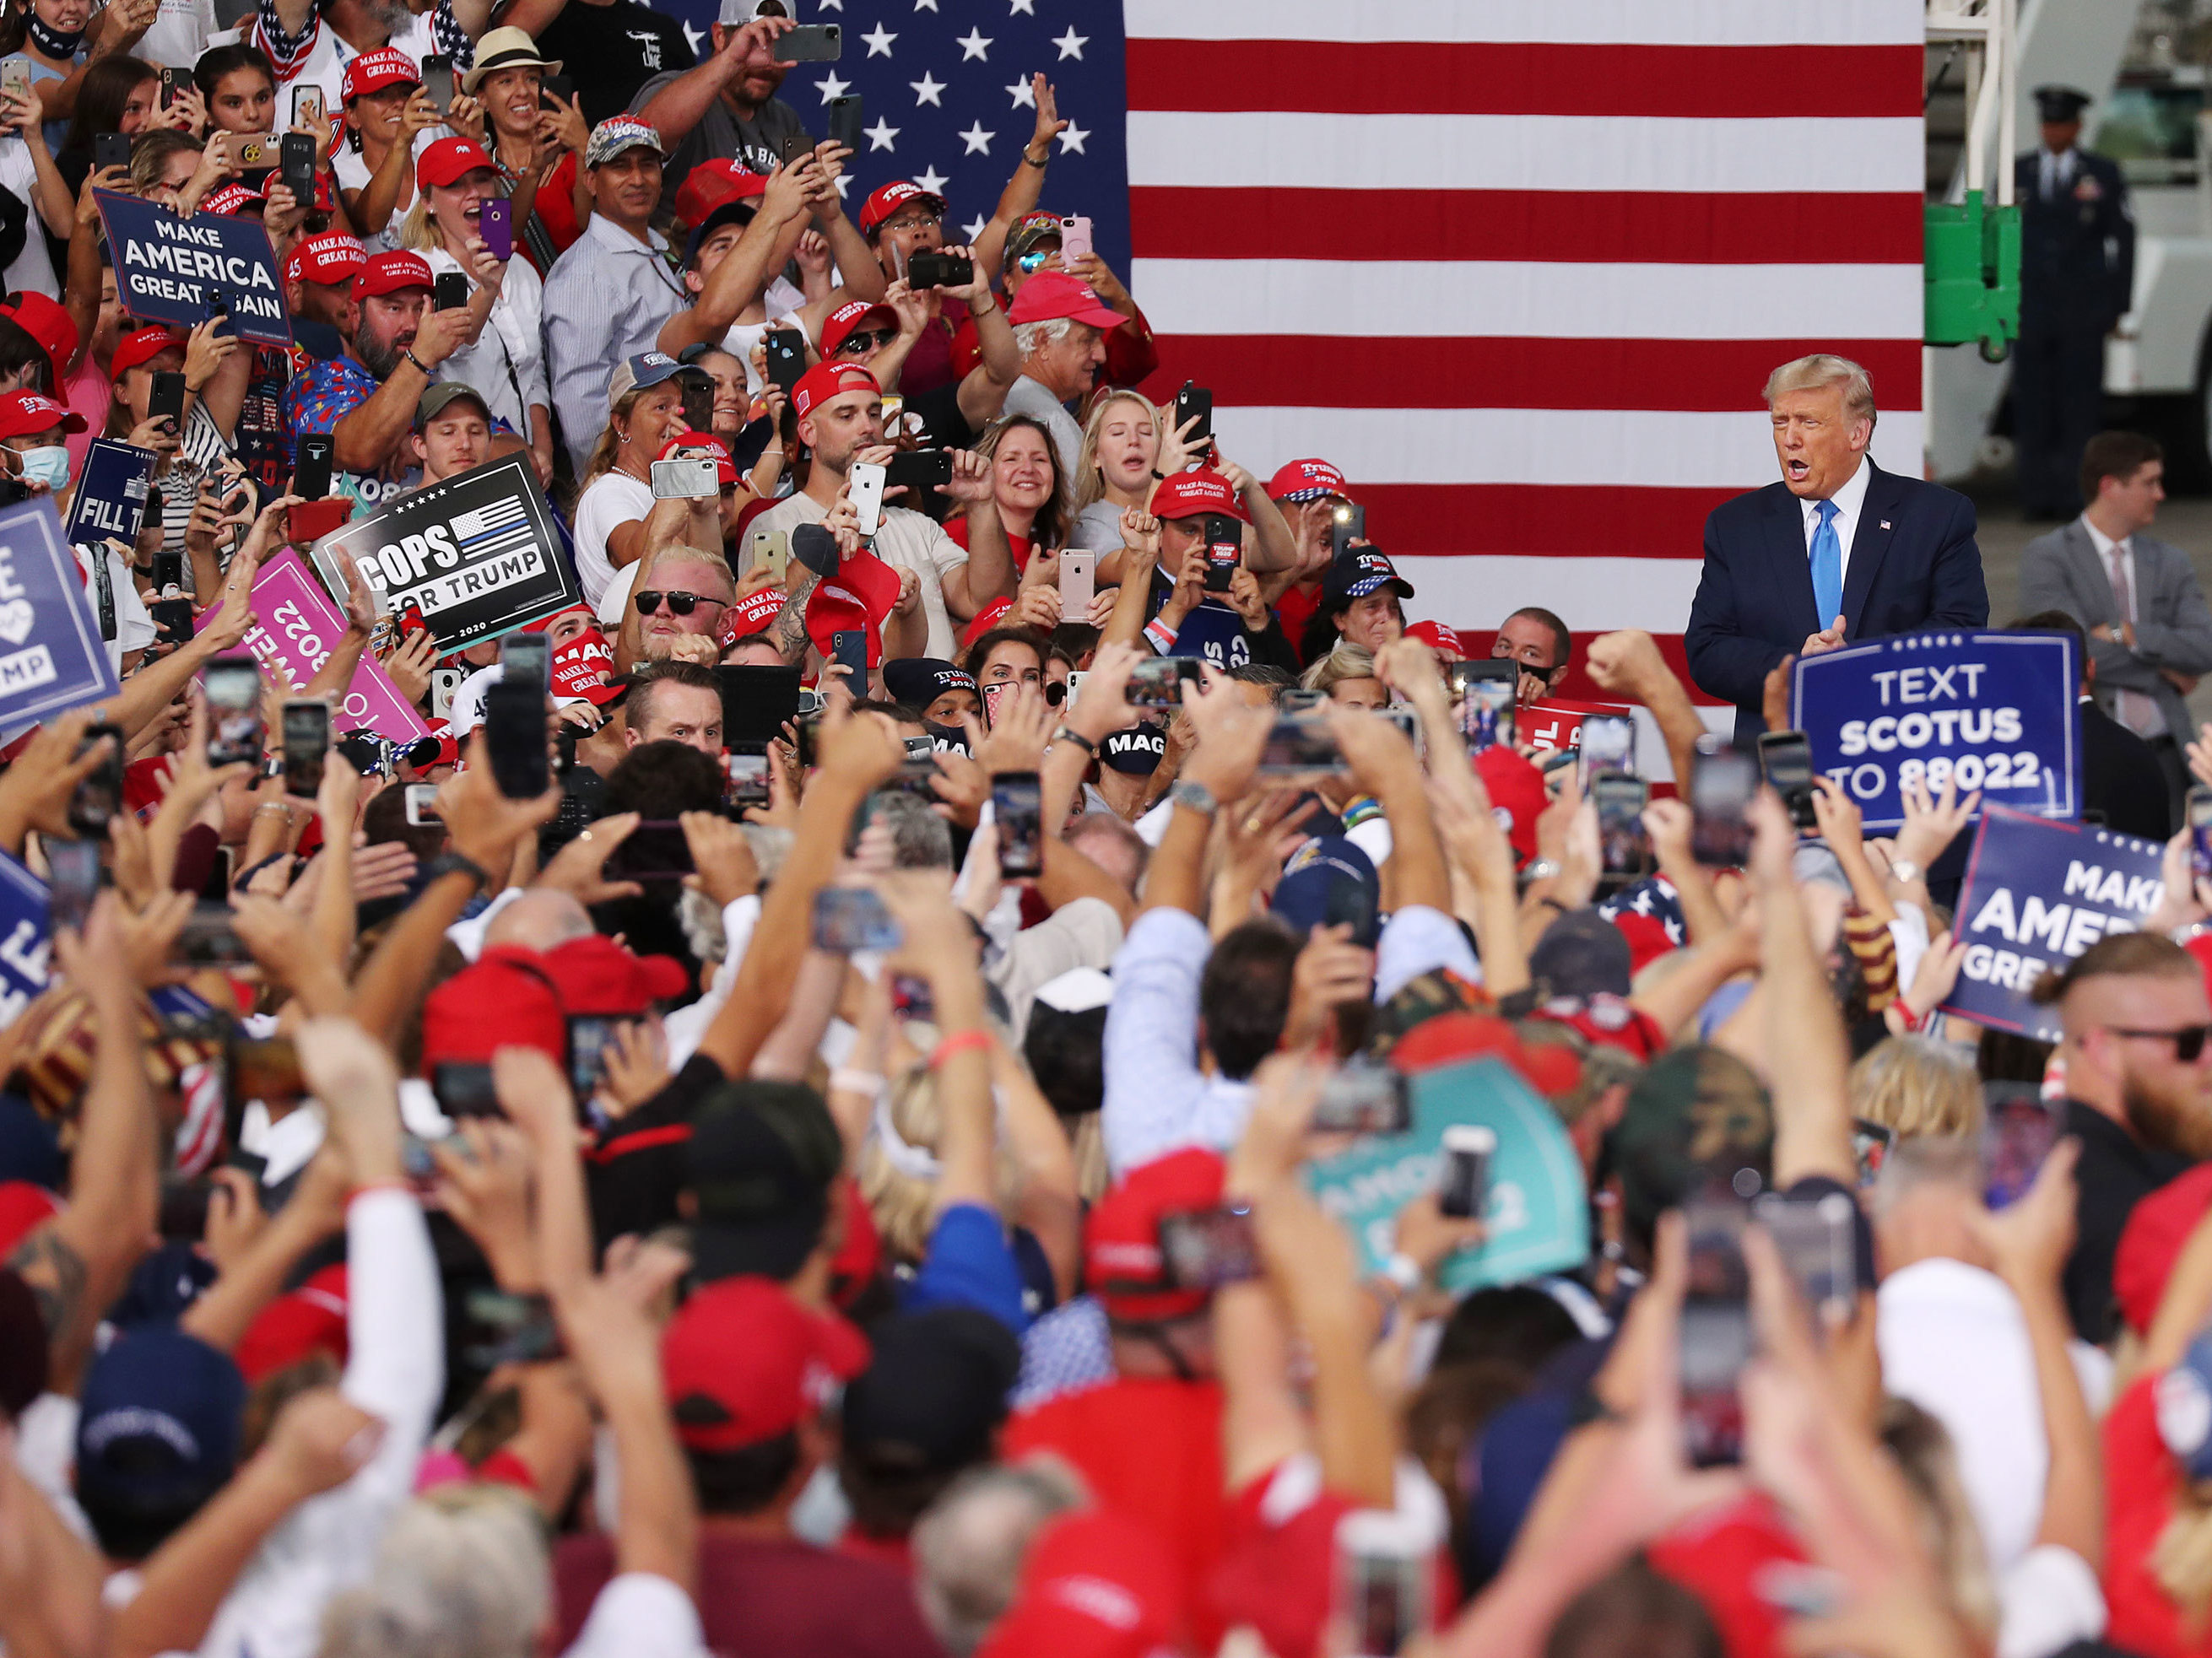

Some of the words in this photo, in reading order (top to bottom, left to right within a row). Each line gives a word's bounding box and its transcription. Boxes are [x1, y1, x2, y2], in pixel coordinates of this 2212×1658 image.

[360, 52, 387, 68] MAKE
[366, 63, 397, 78] GREAT
[613, 124, 648, 139] 2020
[207, 187, 233, 211] MAKE
[216, 196, 245, 214] GREAT
[155, 219, 224, 249] MAKE
[308, 237, 337, 254] MAKE
[125, 239, 277, 291] AMERICA
[317, 249, 348, 267] GREAT
[381, 262, 403, 272] MAKE
[386, 268, 410, 278] GREAT
[130, 273, 203, 305] GREAT
[214, 289, 282, 320] AIN
[1175, 481, 1197, 492] MAKE
[1314, 475, 1338, 485] 2020
[1179, 488, 1203, 498] GREAT
[78, 496, 126, 533] FILL
[354, 524, 459, 592] COPS
[446, 550, 538, 599] TRUMP
[735, 593, 766, 614] MAKE
[747, 602, 779, 623] GREAT
[459, 621, 487, 637] 2020
[554, 664, 584, 683] MAKE
[571, 675, 600, 694] GREAT
[950, 679, 976, 690] 2020
[1870, 662, 1987, 707] TEXT
[1838, 706, 2024, 756] SCOTUS
[1825, 762, 1887, 800] TO
[1897, 751, 2042, 795] 88022
